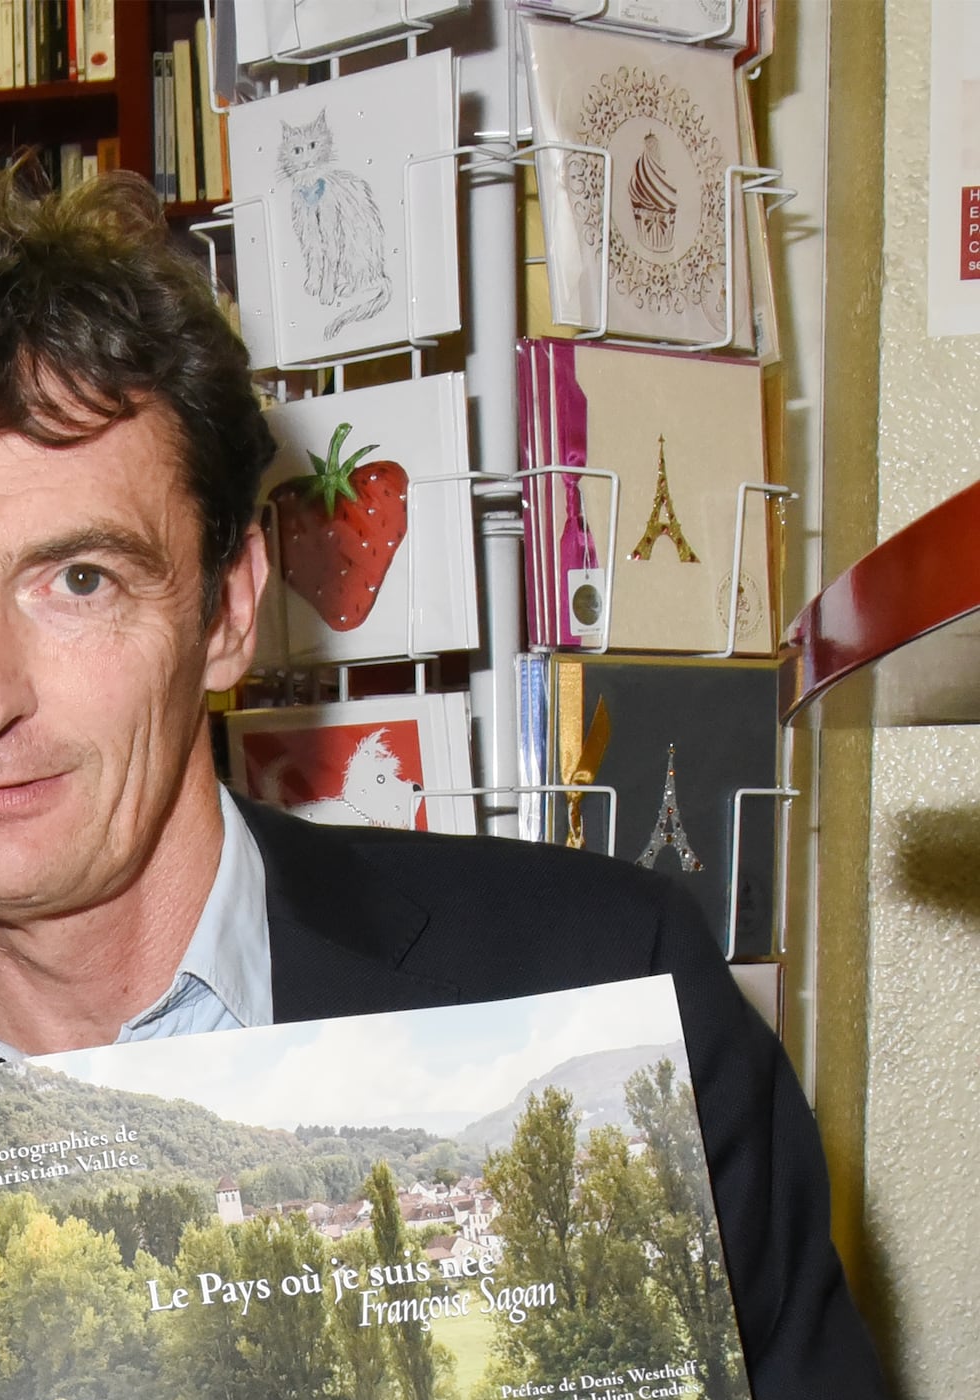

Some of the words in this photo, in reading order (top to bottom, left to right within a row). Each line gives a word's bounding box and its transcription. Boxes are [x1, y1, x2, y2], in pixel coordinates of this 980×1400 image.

[115, 1124, 138, 1144] de
[76, 1150, 140, 1173] Vallée
[146, 1280, 189, 1312] Le
[197, 1272, 271, 1316] Pays
[281, 1263, 323, 1297] où
[331, 1256, 359, 1305] je
[369, 1250, 431, 1288] suis
[439, 1247, 496, 1279] née
[359, 1285, 471, 1332] Françoise
[480, 1276, 557, 1324] Sagan
[501, 1381, 556, 1399] Préface
[559, 1377, 576, 1393] de
[580, 1371, 624, 1390] Denis
[627, 1360, 697, 1383] Westhoff
[638, 1381, 701, 1400] Cendres
